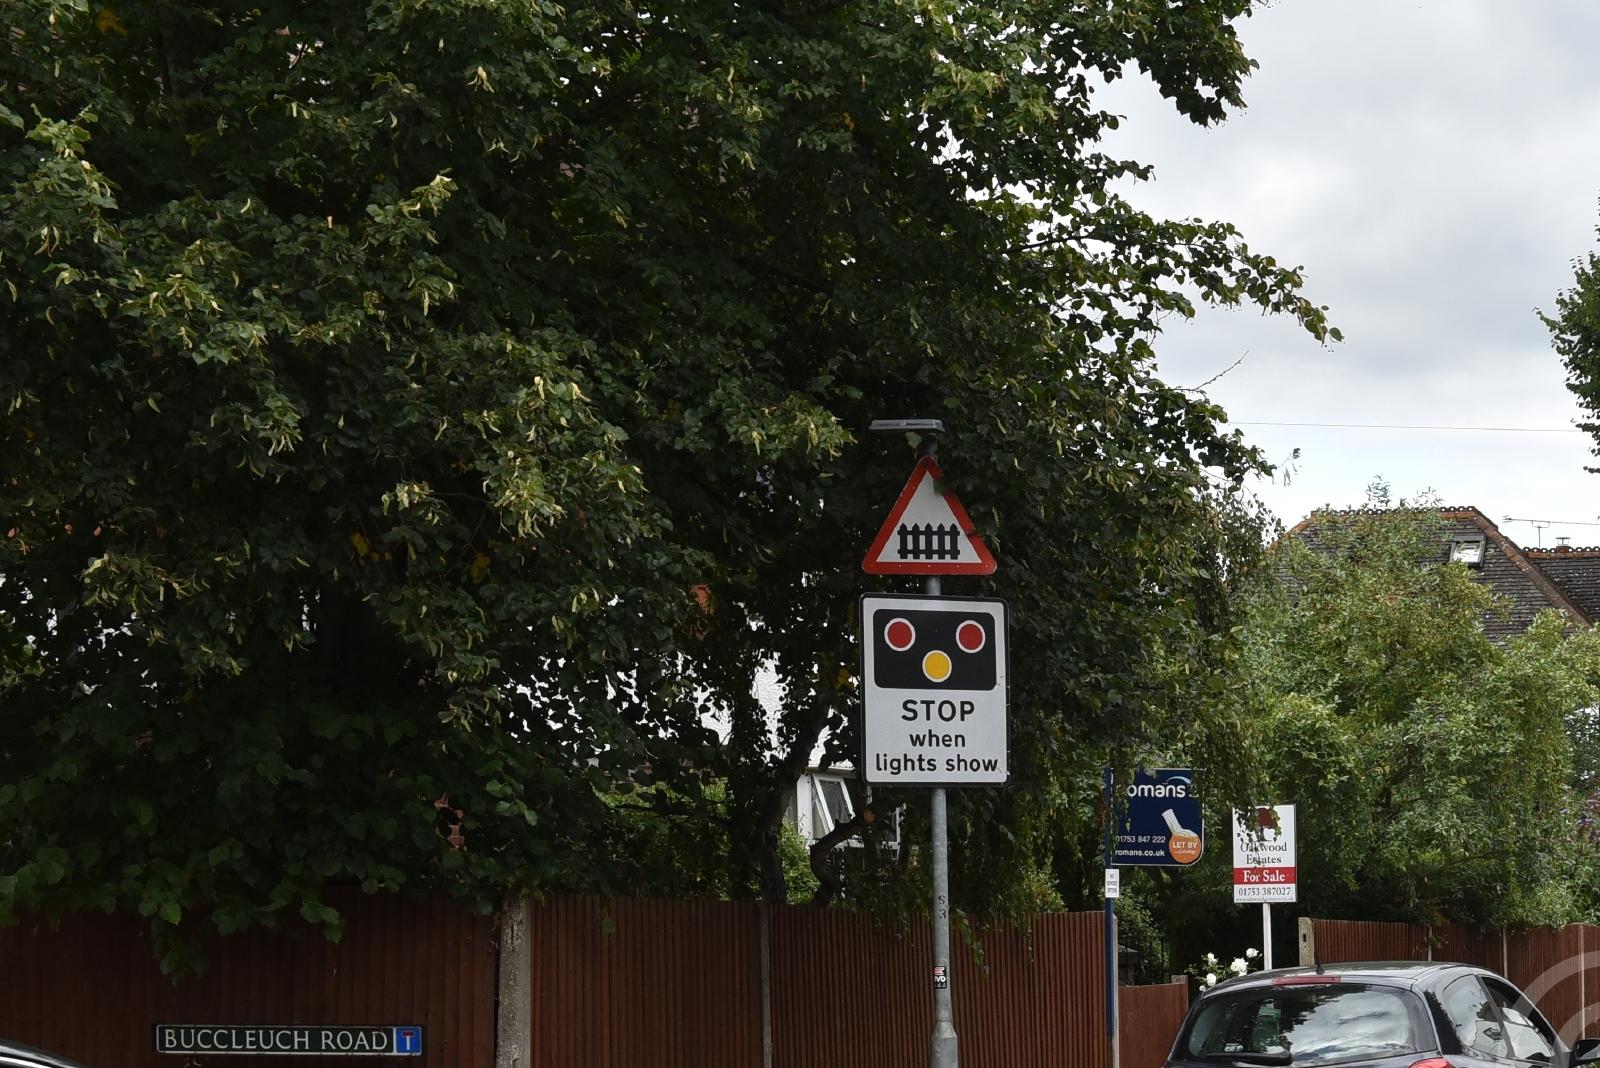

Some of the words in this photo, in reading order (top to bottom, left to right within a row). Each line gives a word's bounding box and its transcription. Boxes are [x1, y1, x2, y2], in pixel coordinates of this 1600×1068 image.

[901, 699, 975, 722] STOP
[909, 729, 966, 748] when
[875, 753, 937, 775] lights
[945, 754, 998, 772] show
[1117, 784, 1186, 798] omans
[1137, 835, 1150, 843] 847
[1152, 835, 1166, 843] 222
[1172, 841, 1186, 849] LET
[1115, 849, 1165, 857] romans.co.uk
[1243, 870, 1260, 883] For
[1262, 869, 1286, 882] Sale
[1238, 887, 1260, 896] 01753
[1261, 886, 1292, 896] 387027
[164, 1028, 310, 1050] BUCCLEUCH
[320, 1031, 388, 1051] ROAD
